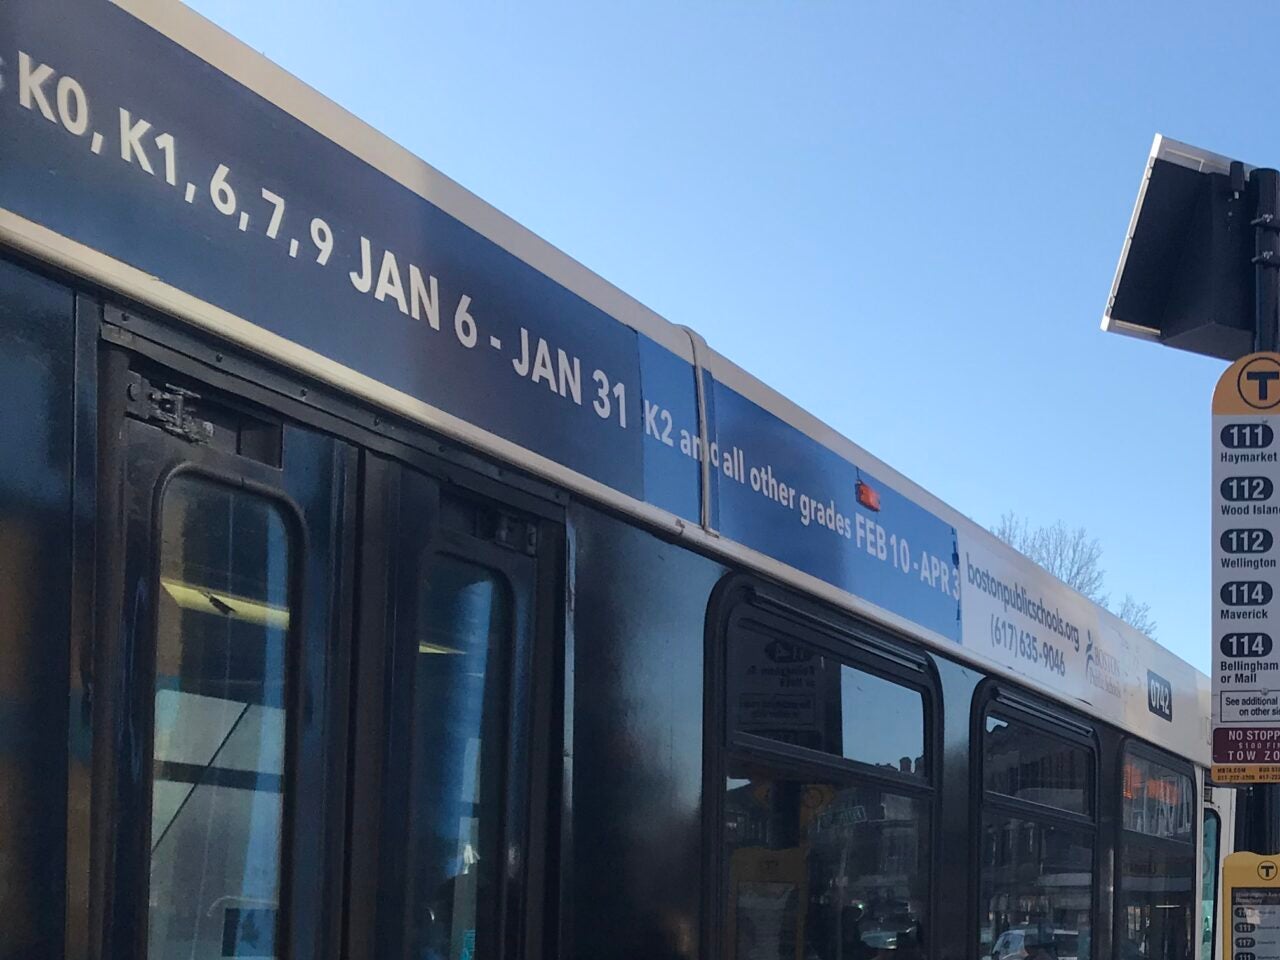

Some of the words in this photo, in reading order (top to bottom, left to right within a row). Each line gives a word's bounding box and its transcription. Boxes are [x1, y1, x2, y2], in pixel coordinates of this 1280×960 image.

[349, 235, 440, 332] JAN
[454, 293, 478, 349] 6
[511, 326, 583, 406] JAN
[592, 368, 627, 429] 31
[1246, 371, 1280, 401] T
[1229, 425, 1264, 447] 111
[1220, 451, 1278, 465] Haymarket
[1228, 478, 1265, 500] 112
[644, 399, 674, 447] K2
[722, 446, 745, 484] all
[749, 465, 795, 510] other
[799, 492, 851, 540] grades
[855, 511, 888, 562] FEB
[889, 533, 910, 574] 10
[920, 550, 951, 596] APR
[1220, 504, 1250, 516] Wood
[1228, 530, 1265, 552] 112
[1220, 556, 1277, 570] Wellington
[1228, 582, 1265, 604] 114
[965, 551, 1080, 653] bostonpublicschools.org
[1220, 608, 1269, 620] Maverick
[1228, 635, 1265, 656] 114
[1220, 660, 1279, 673] Bellingham
[1220, 674, 1231, 684] or
[1234, 673, 1257, 684] Mall
[1150, 680, 1171, 716] 0742
[1225, 696, 1240, 706] See
[1241, 696, 1279, 706] additional
[1238, 708, 1249, 717] on
[1250, 707, 1270, 717] other
[1228, 730, 1244, 741] NO
[1228, 750, 1256, 761] TOW
[1260, 865, 1275, 878] T
